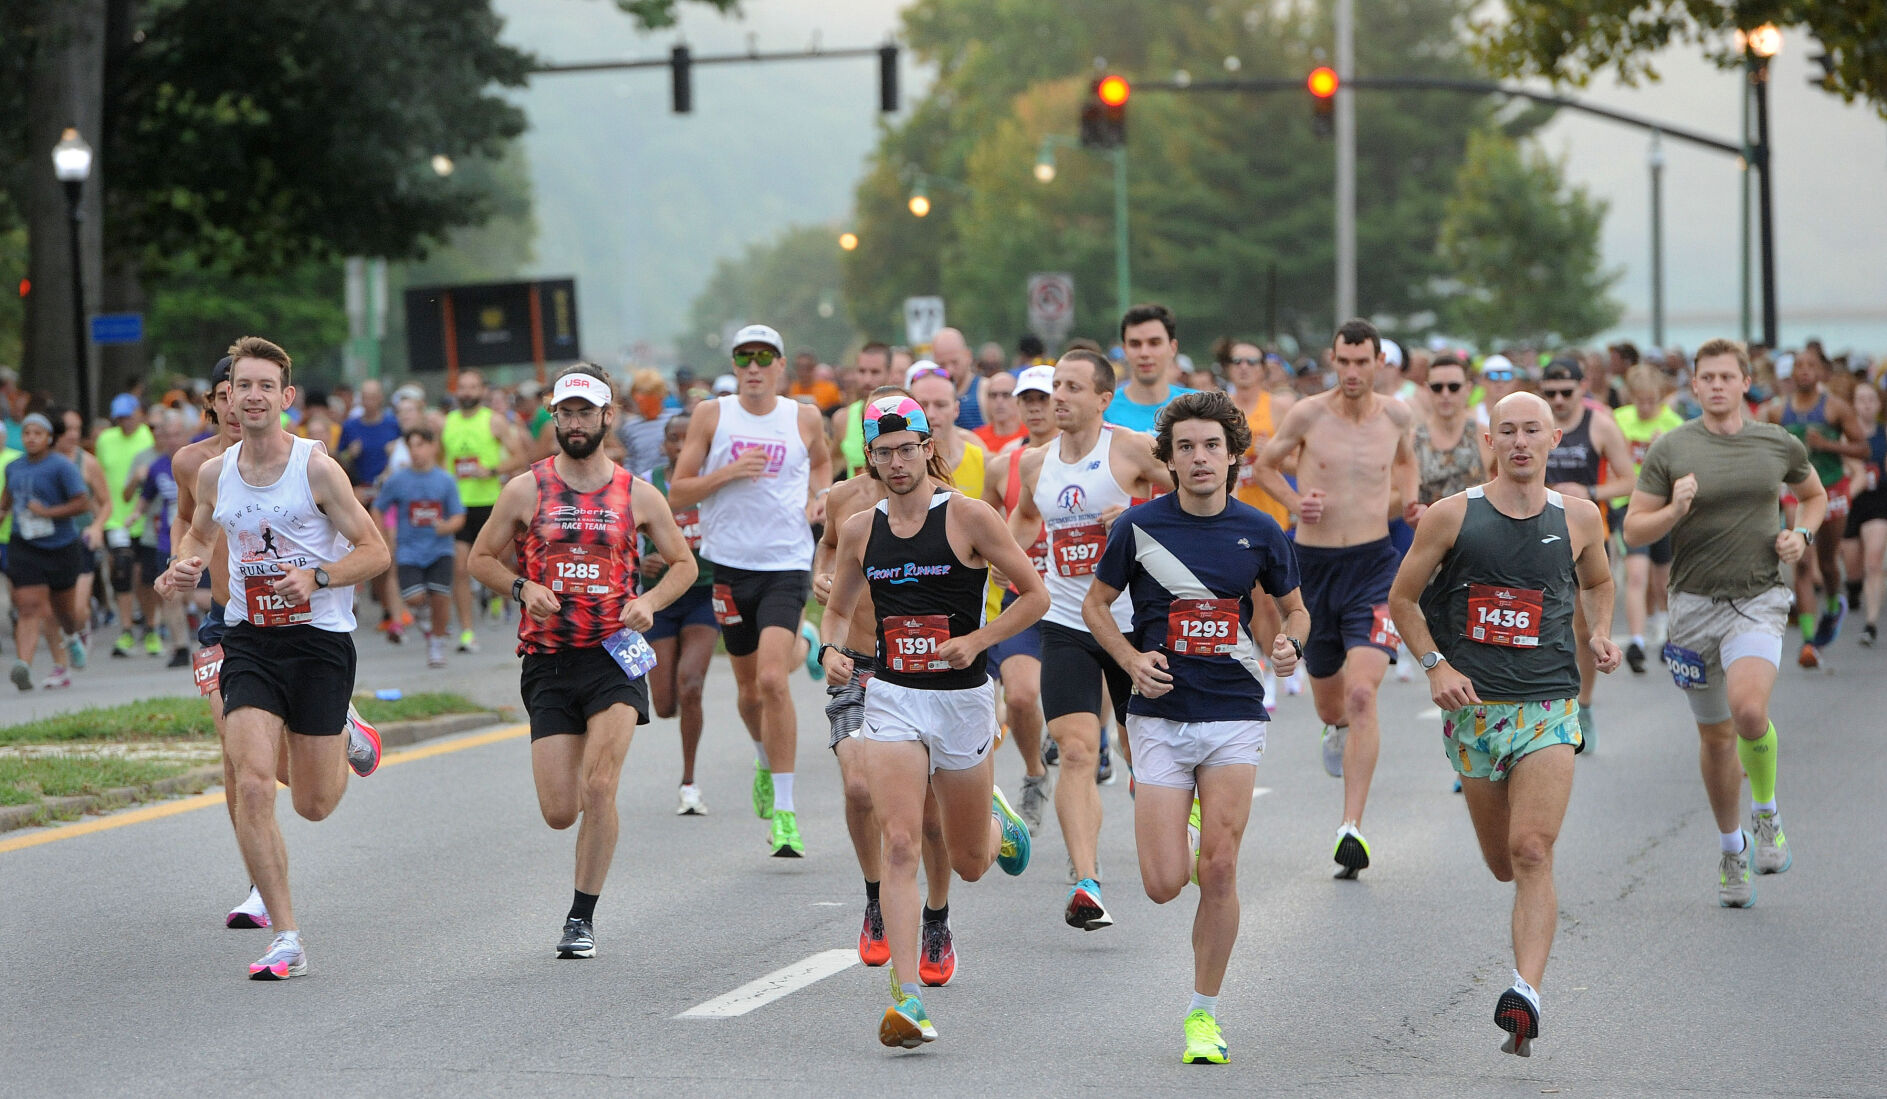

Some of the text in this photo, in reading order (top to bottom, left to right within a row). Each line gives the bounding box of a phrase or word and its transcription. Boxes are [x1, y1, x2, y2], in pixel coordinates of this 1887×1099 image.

[565, 379, 590, 388] USA
[228, 504, 305, 533] EWEL CITY
[561, 522, 606, 530] RACE TEAM
[1060, 543, 1099, 562] 1397
[239, 557, 307, 576] RUN CUB
[556, 562, 600, 579] 1285
[867, 563, 952, 580] FRONT RUNNER
[1477, 607, 1530, 629] 1436
[1180, 620, 1229, 637] 1293
[618, 636, 649, 664] 306
[895, 637, 937, 655] 1391
